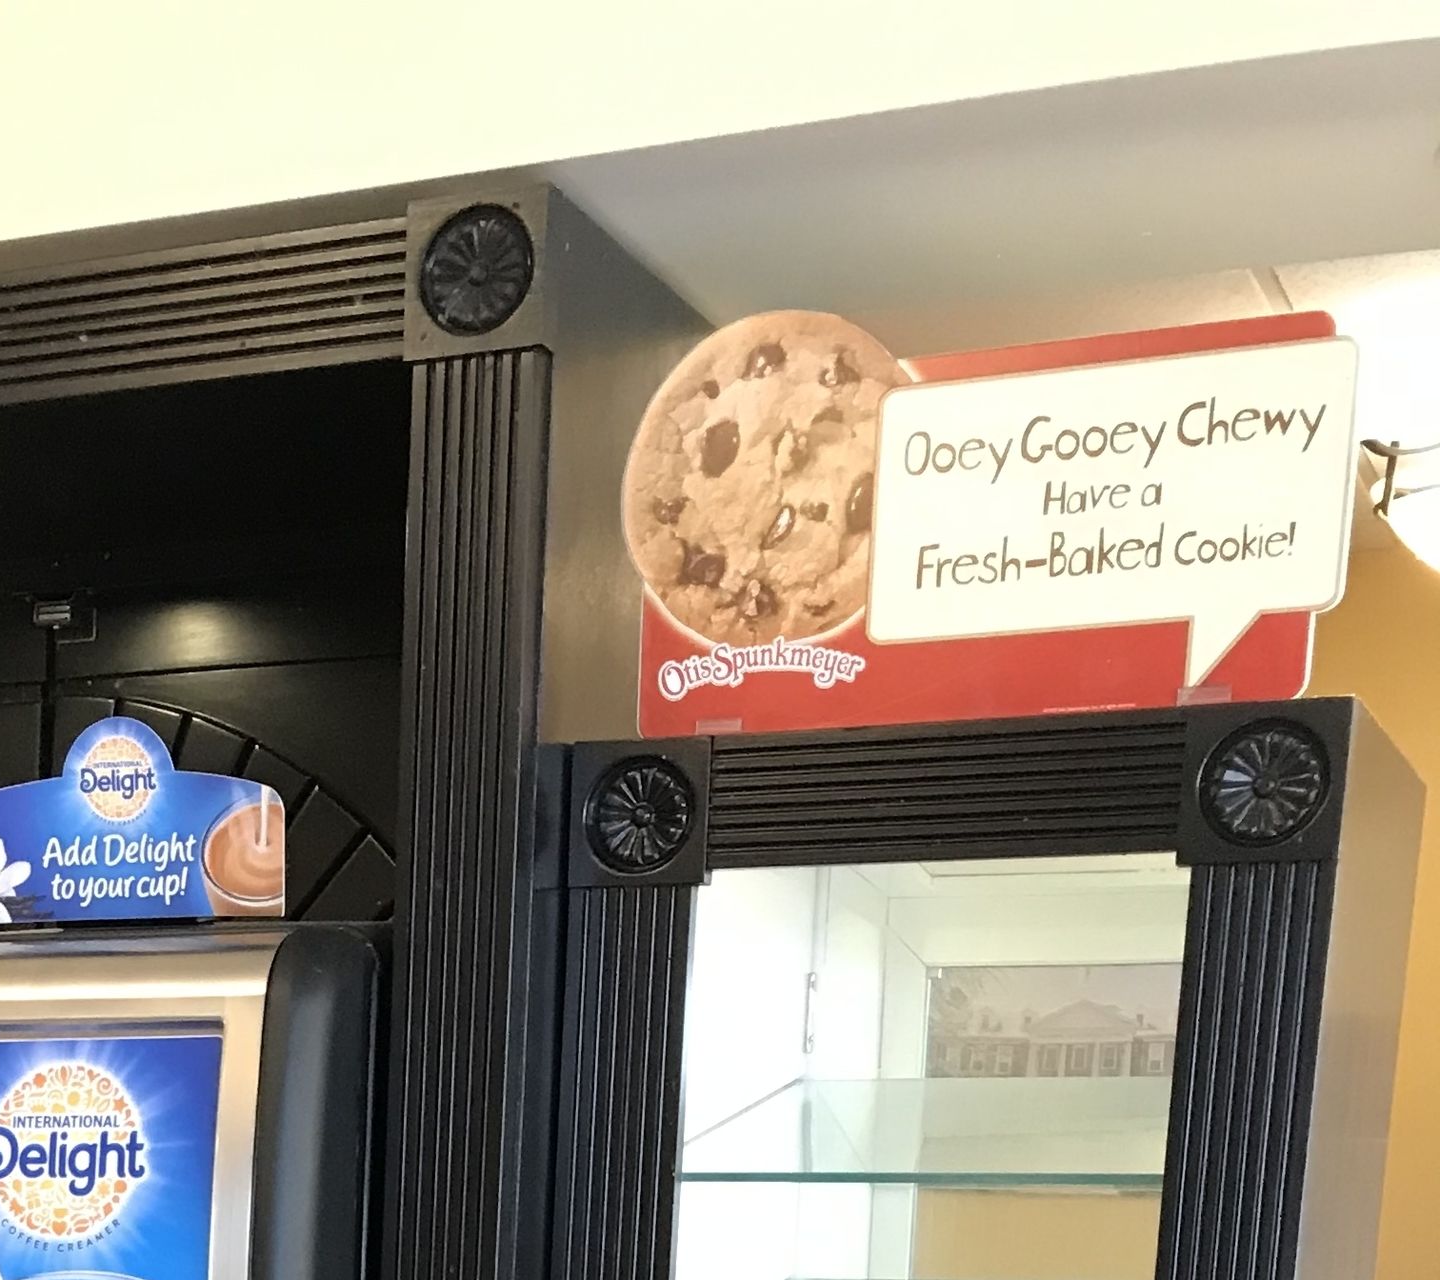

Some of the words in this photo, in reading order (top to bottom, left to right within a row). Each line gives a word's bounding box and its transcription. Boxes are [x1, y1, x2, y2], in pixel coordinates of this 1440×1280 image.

[904, 431, 1014, 484] Ooey
[1021, 415, 1167, 468] Gooey
[1177, 396, 1327, 452] Chewy
[1042, 481, 1131, 516] Have
[1140, 482, 1163, 507] a
[916, 522, 1166, 590] Fresh-Baked
[1174, 521, 1297, 567] Cookie!
[661, 658, 711, 696] Otis
[712, 639, 862, 684] Spunkmeyer
[80, 767, 157, 800] Delight
[93, 761, 144, 769] INTERNATIONAL
[42, 834, 98, 869] Add
[103, 831, 197, 872] Delight
[51, 873, 76, 900] to
[78, 876, 136, 908] your
[136, 866, 188, 906] cup!
[11, 1114, 120, 1129] INTERNATIONAL
[0, 1217, 50, 1252] COFFEE
[56, 1217, 121, 1253] CREAMER
